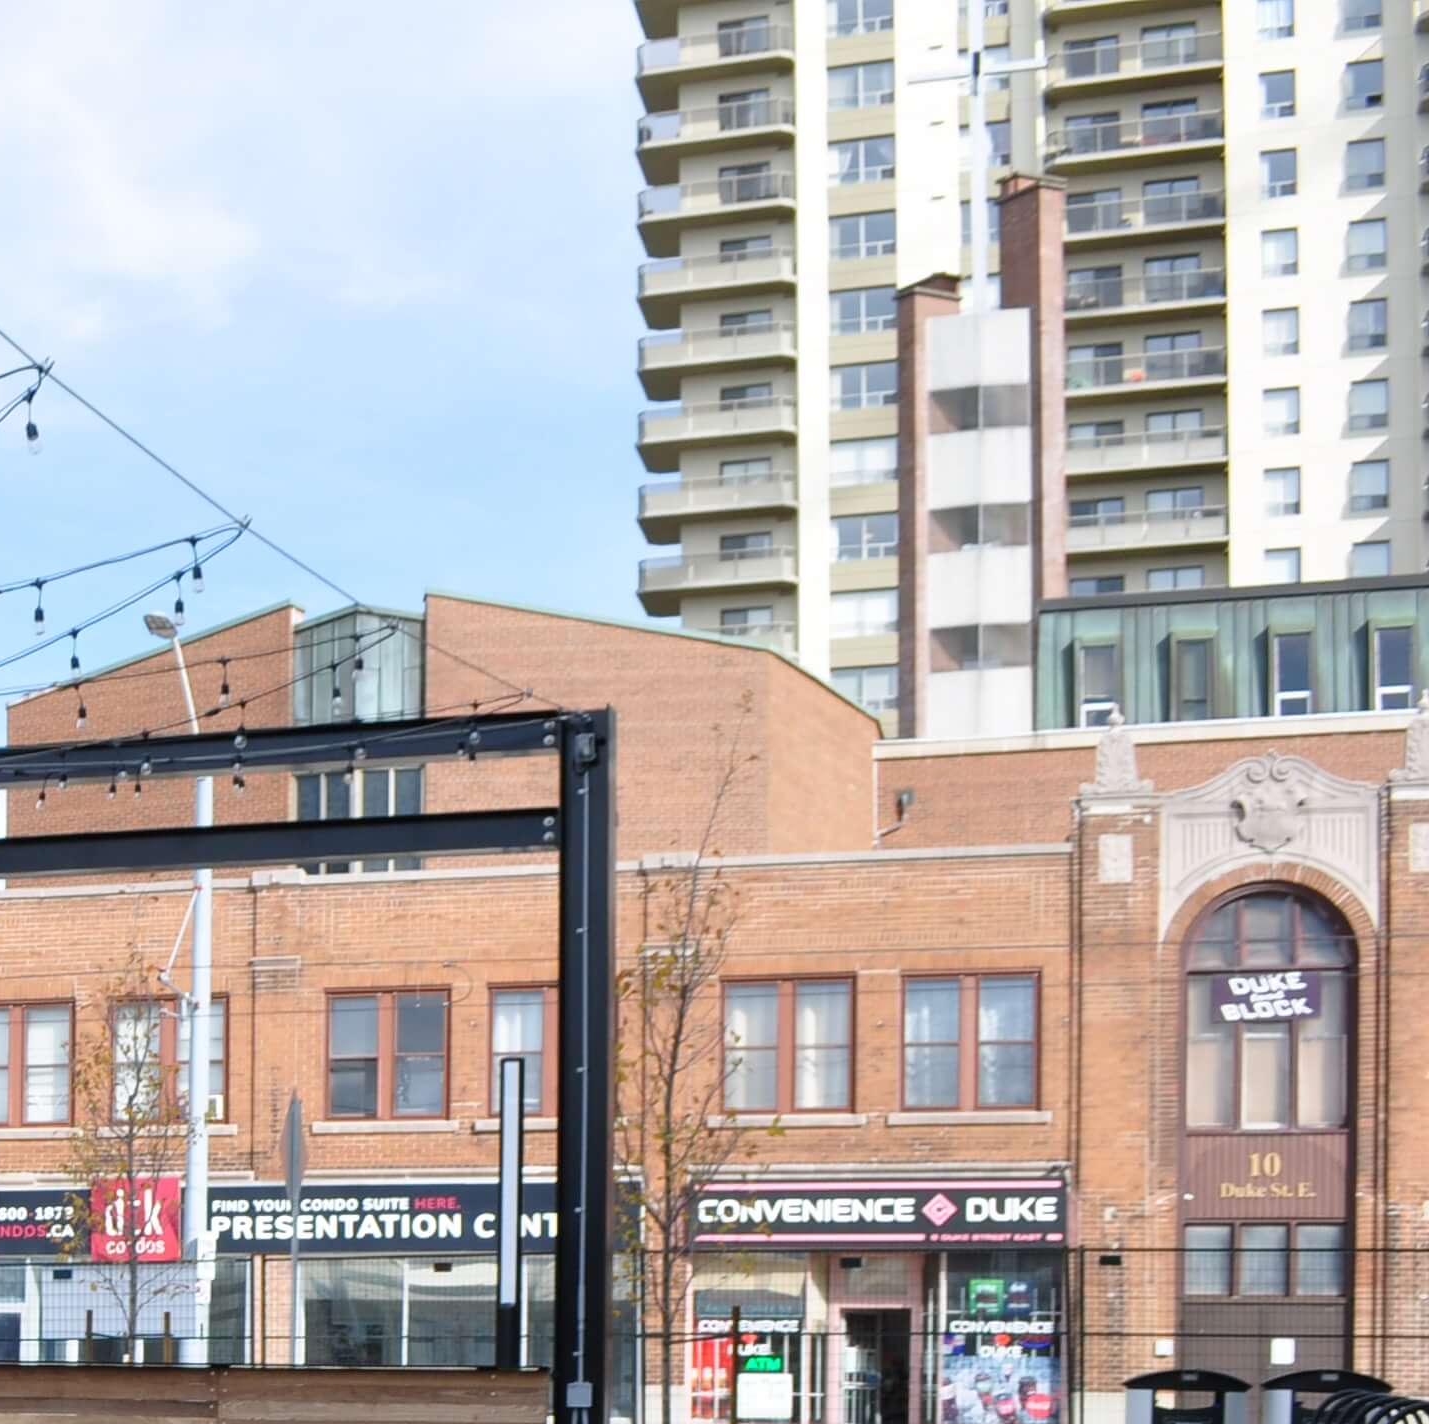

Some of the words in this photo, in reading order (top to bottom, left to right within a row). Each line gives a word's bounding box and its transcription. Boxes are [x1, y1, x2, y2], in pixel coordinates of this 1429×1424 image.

[1228, 971, 1309, 996] DUKE
[1221, 998, 1314, 1022] BLOCK
[1249, 1152, 1282, 1177] 10
[1220, 1182, 1268, 1198] Duke
[1297, 1182, 1318, 1197] E.
[211, 1199, 251, 1213] FIND
[300, 1198, 359, 1212] CONDO
[362, 1197, 410, 1211] SUITE
[414, 1196, 462, 1211] HERE.
[697, 1198, 916, 1224] CONVENIENCE
[965, 1196, 1059, 1223] DUKE
[210, 1213, 463, 1241] PRESENTATION
[105, 1236, 166, 1255] codos
[744, 1356, 782, 1371] ATM
